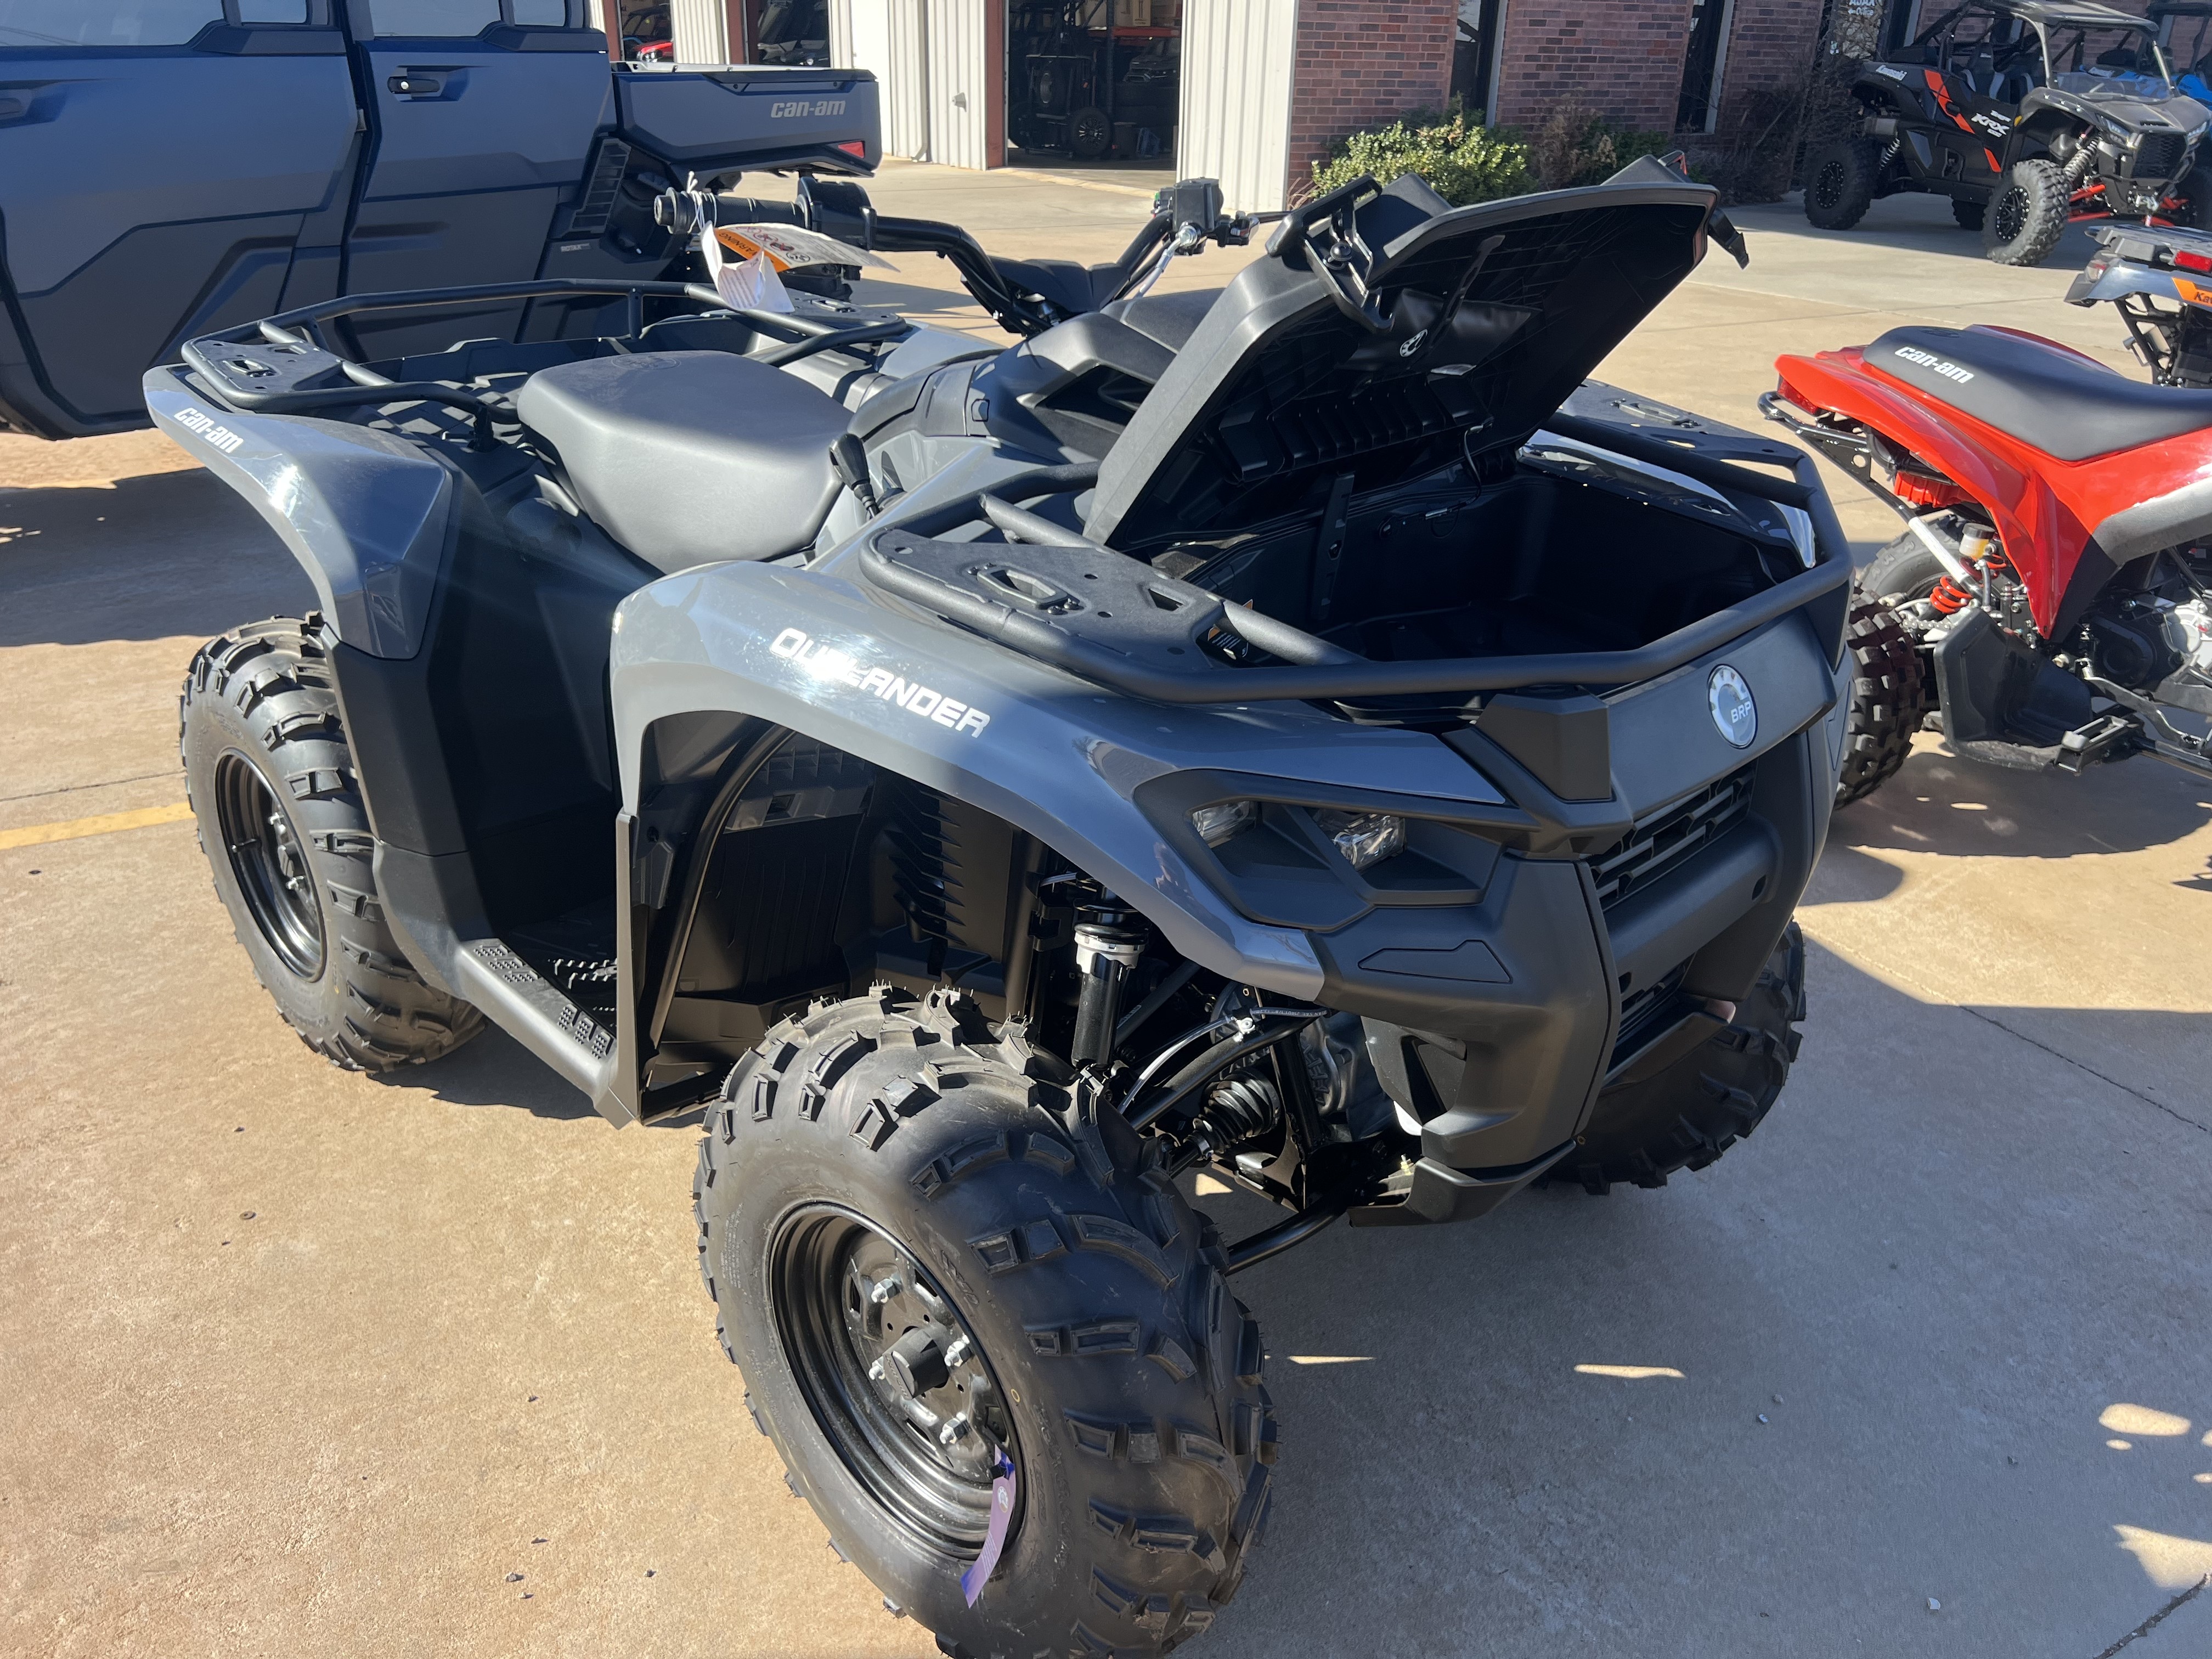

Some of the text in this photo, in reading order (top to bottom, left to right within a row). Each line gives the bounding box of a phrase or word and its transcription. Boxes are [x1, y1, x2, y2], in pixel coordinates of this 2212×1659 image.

[771, 100, 846, 119] can-am
[1971, 113, 2010, 135] KRX
[1894, 346, 1974, 384] can-am
[173, 407, 244, 454] can-am
[1730, 701, 1752, 724] BRP
